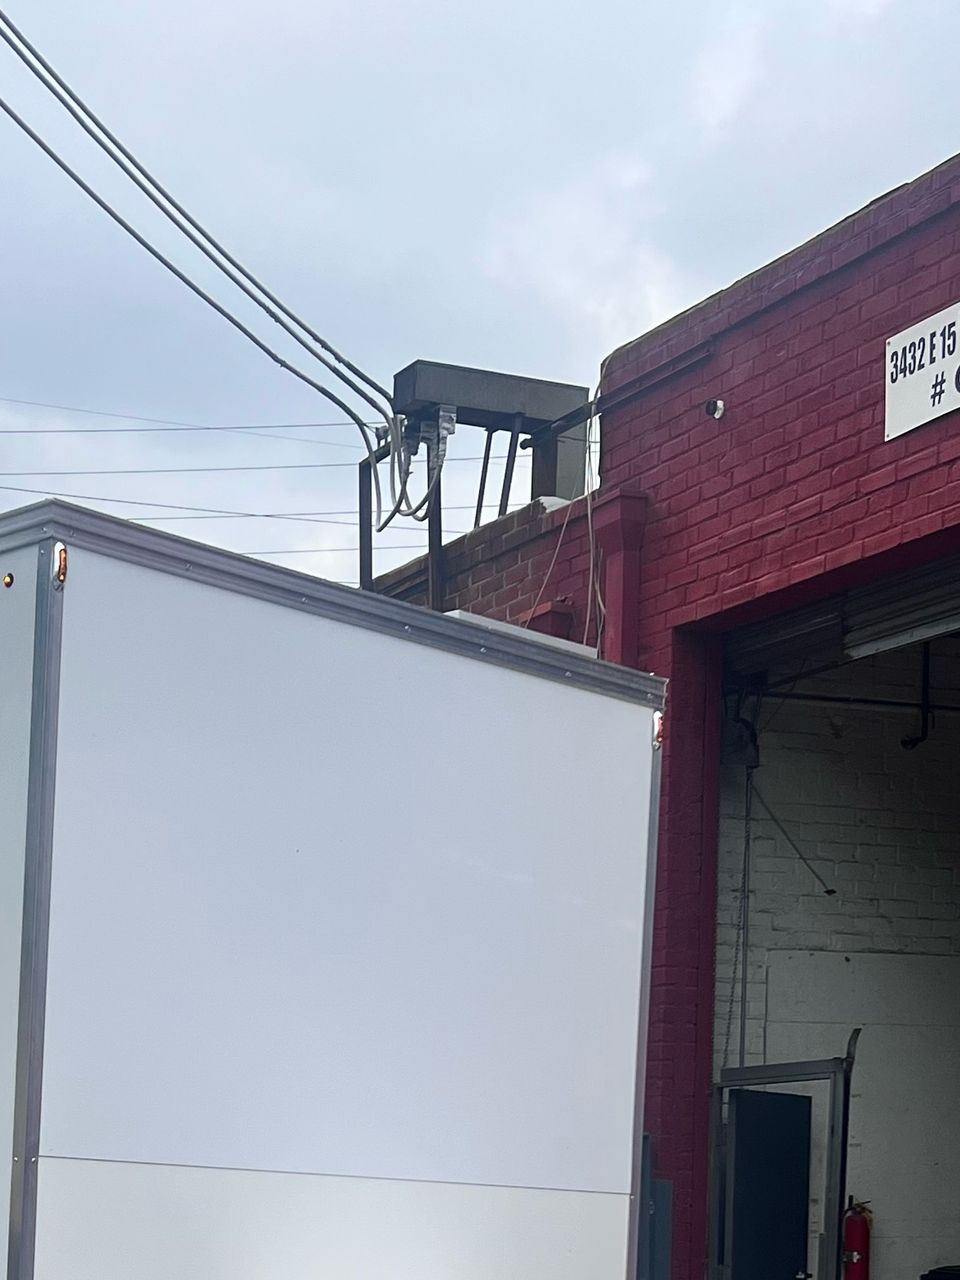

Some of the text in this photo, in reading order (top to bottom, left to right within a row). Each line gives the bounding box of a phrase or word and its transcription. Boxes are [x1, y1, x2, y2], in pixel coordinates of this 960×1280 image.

[890, 337, 926, 384] 3432
[930, 331, 937, 365] E
[940, 321, 957, 360] 15
